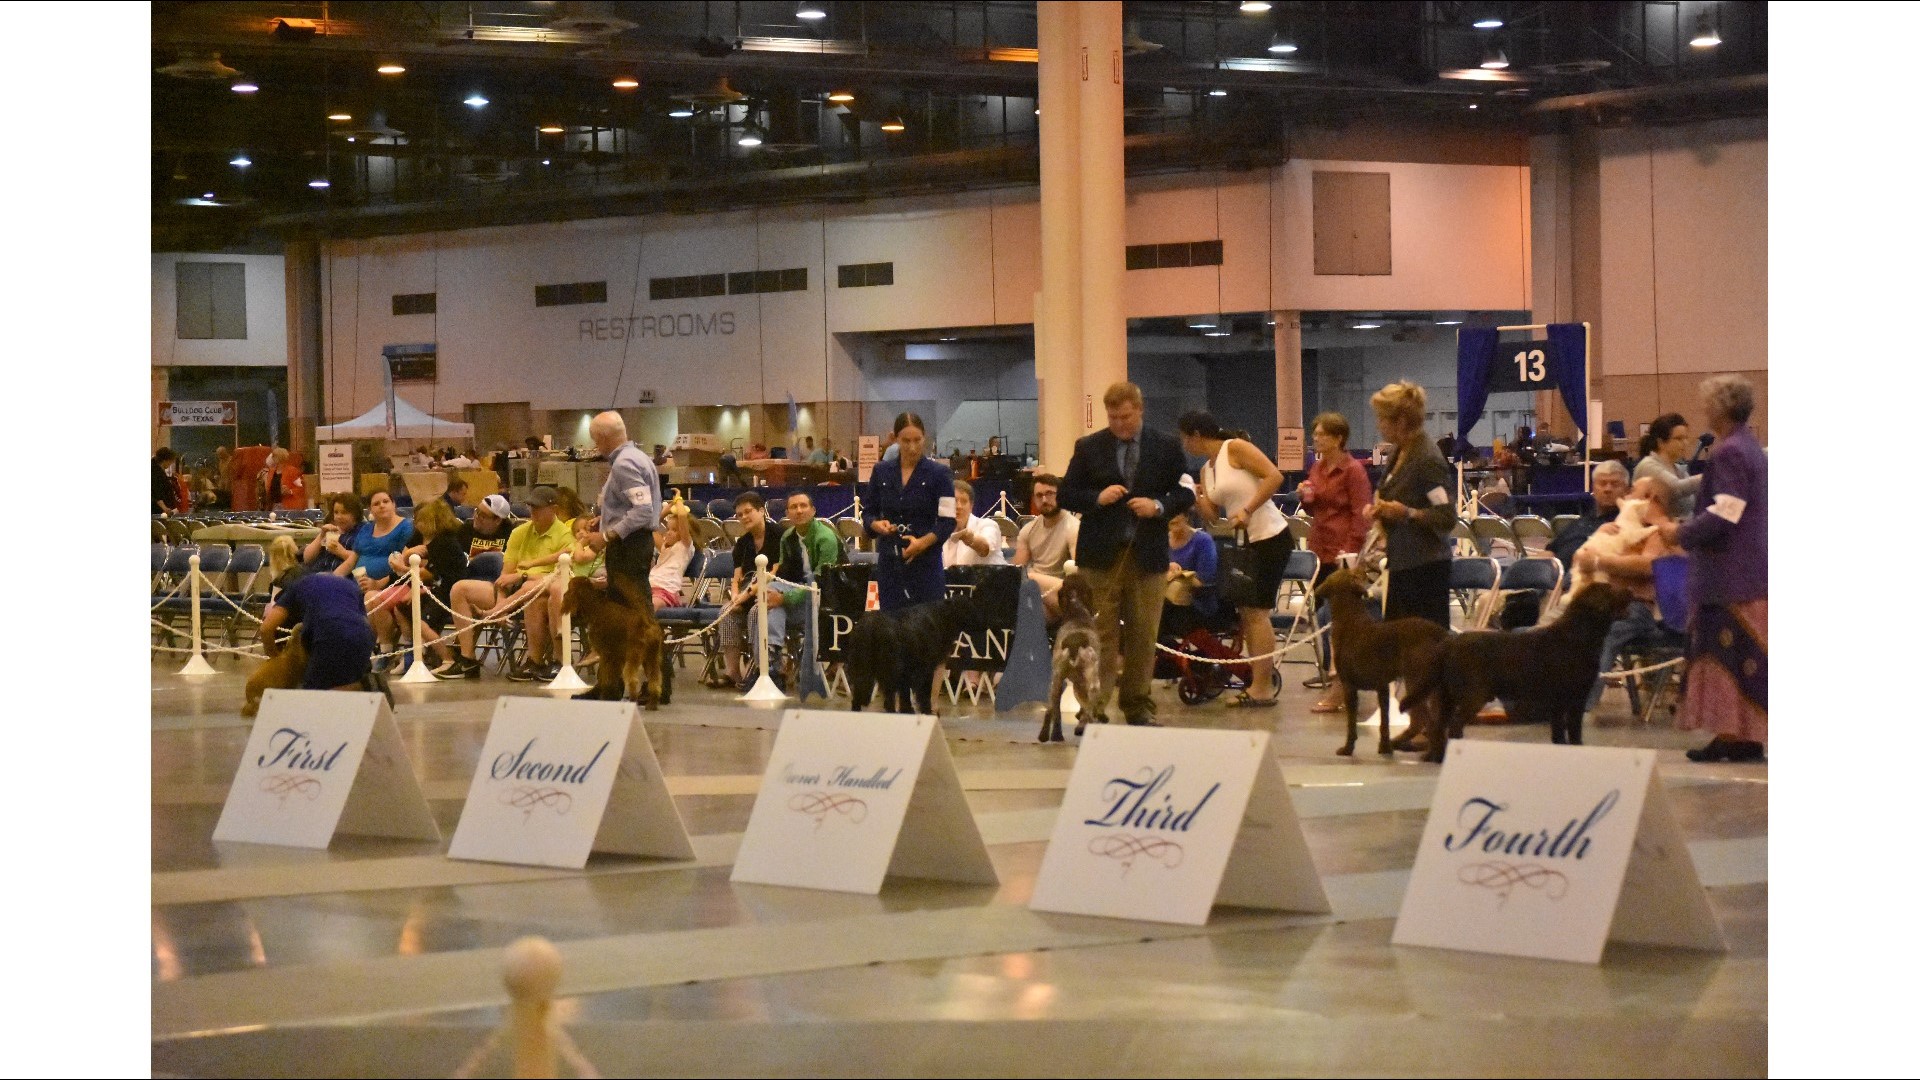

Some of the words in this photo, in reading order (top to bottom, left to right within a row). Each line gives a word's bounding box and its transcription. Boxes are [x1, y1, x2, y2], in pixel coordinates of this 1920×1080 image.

[579, 311, 736, 342] RESTROOMS
[1513, 349, 1547, 382] 13
[204, 406, 222, 414] CLUB
[257, 727, 348, 772] First
[490, 736, 610, 784] Second
[1084, 764, 1221, 832] Third
[1443, 788, 1621, 860] Fourth
